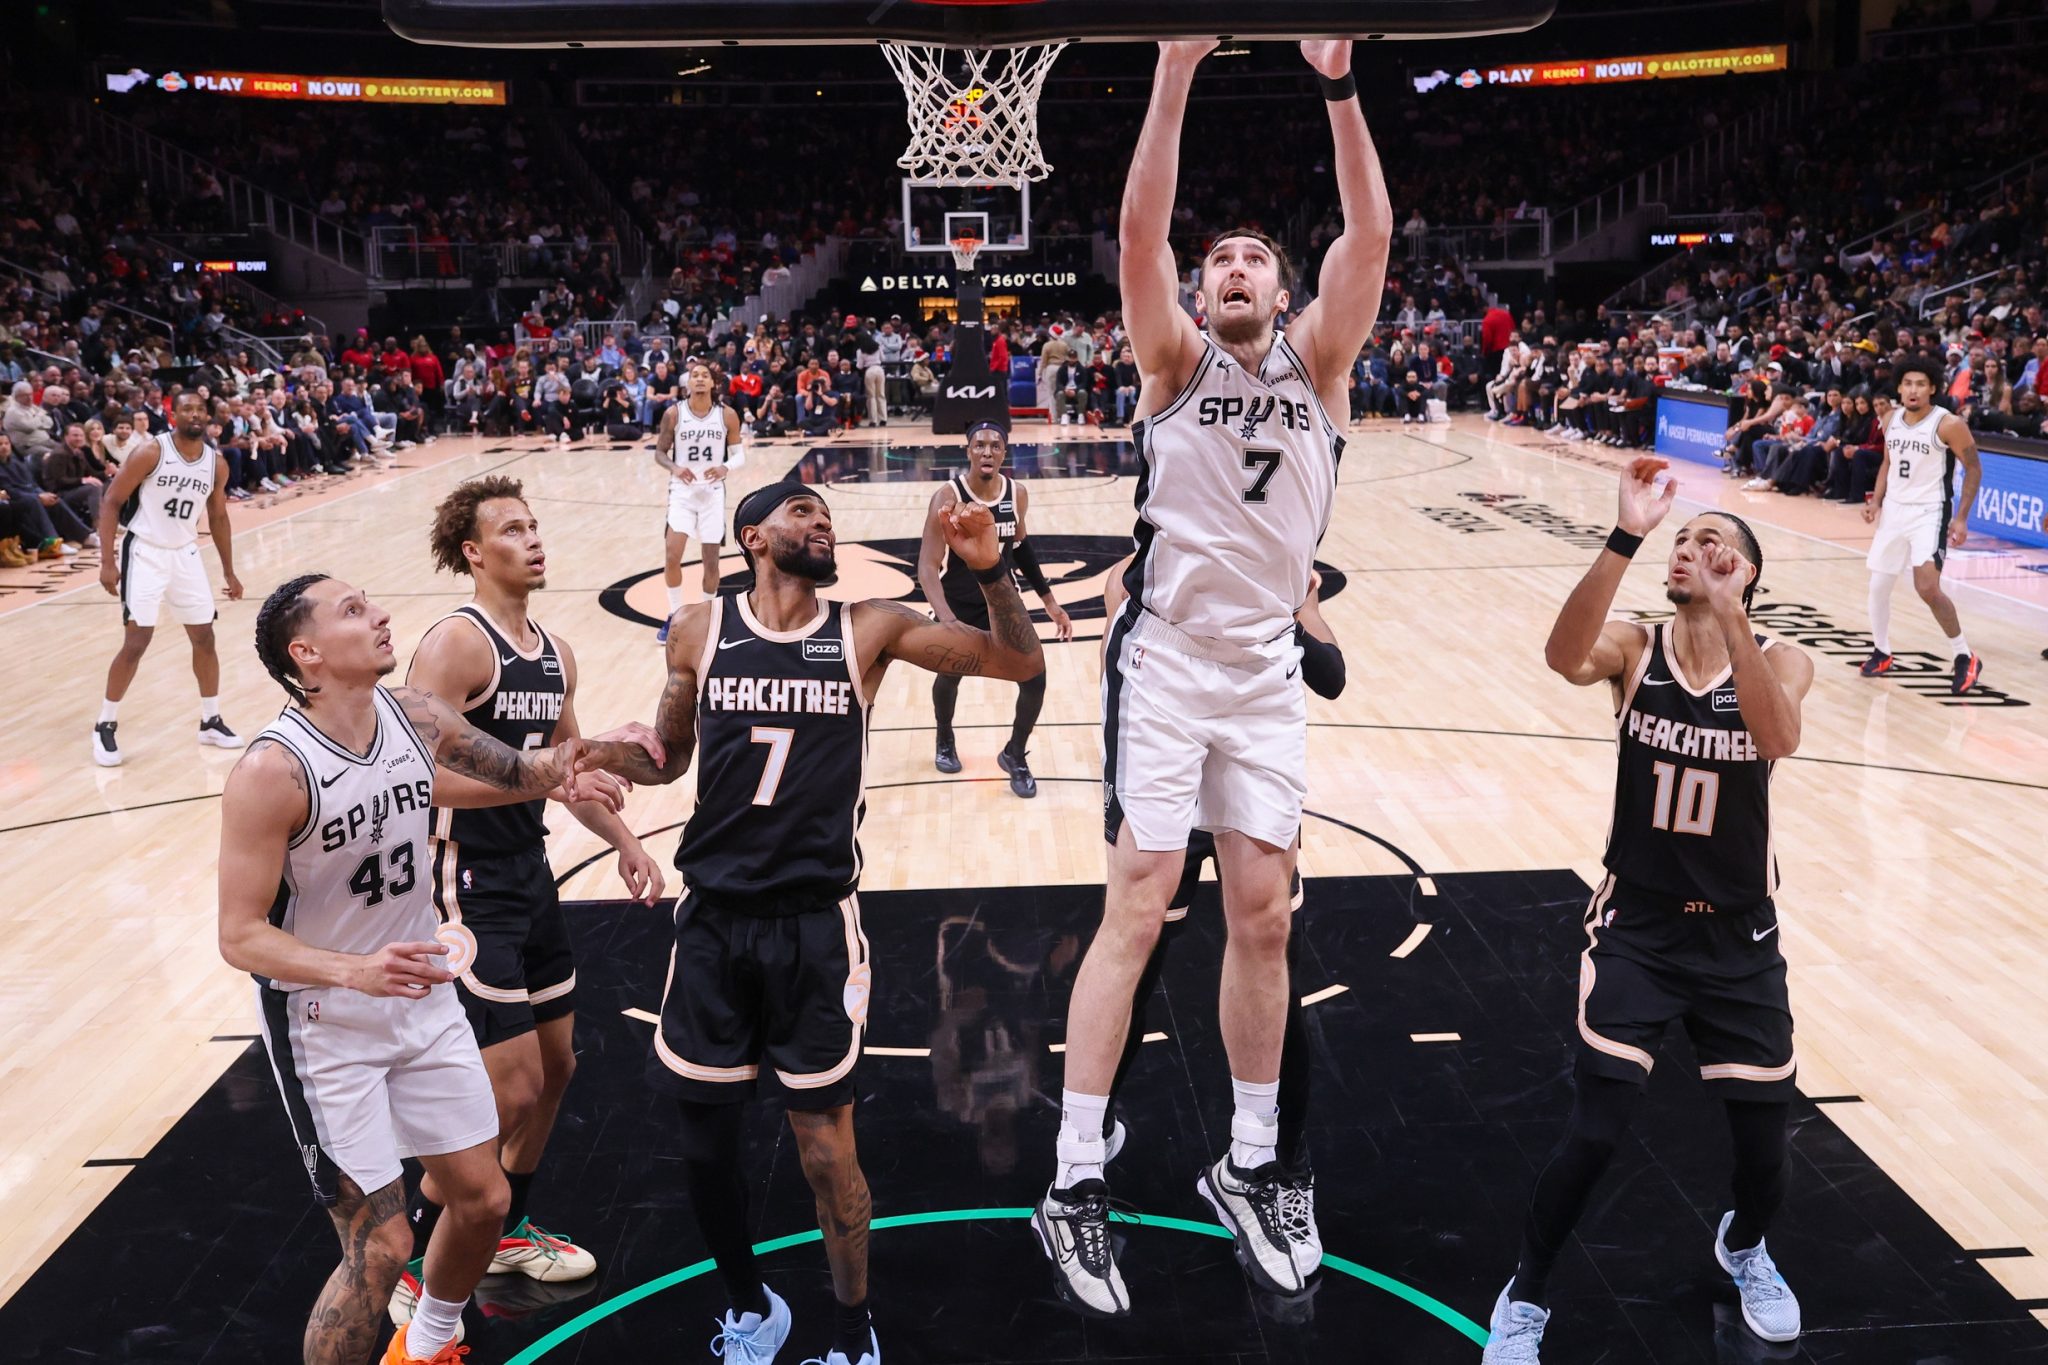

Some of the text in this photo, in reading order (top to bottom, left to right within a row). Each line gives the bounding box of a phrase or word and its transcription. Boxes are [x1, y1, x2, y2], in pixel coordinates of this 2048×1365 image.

[1488, 69, 1534, 84] PLAY
[1542, 67, 1586, 79] KENO!
[1595, 62, 1643, 78] NOW!
[1662, 53, 1775, 71] GALOTTERY.COM
[195, 76, 244, 92] PLAY
[254, 80, 298, 92] KENO!
[308, 82, 361, 96] NOW!
[381, 85, 494, 98] GALOTTERY.COM
[1650, 234, 1677, 246] PLAY
[882, 275, 949, 290] DELTA
[1266, 371, 1295, 388] LEDGER
[946, 385, 996, 399] KIA
[1199, 396, 1311, 441] SPURS
[680, 429, 723, 442] SPURS
[688, 446, 713, 462] 24
[1887, 439, 1931, 455] SPURS
[1242, 448, 1284, 505] 7
[1899, 460, 1912, 479] 2
[157, 475, 210, 495] SPURS
[164, 498, 194, 520] 40
[1976, 485, 2044, 533] KAISER
[806, 643, 840, 655] paze
[493, 691, 565, 721] PEACHTRE
[708, 677, 851, 716] PEACHTREE
[1715, 694, 1737, 707] paz
[386, 753, 411, 769] LEDGER
[751, 726, 796, 807] 7
[1652, 760, 1720, 837] 10
[321, 780, 431, 853] SPURS
[345, 838, 417, 910] 43
